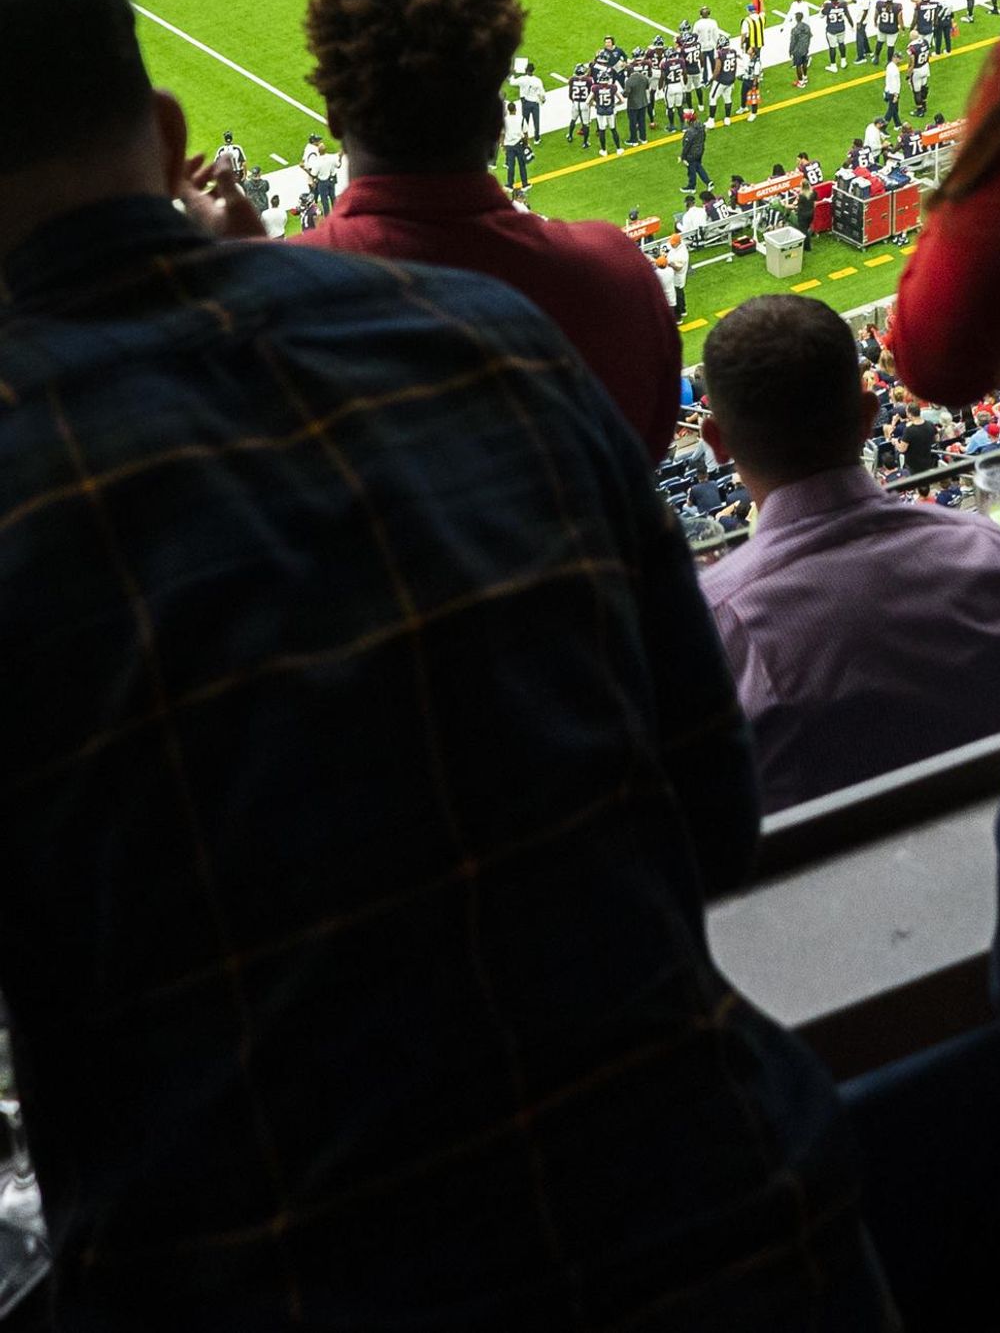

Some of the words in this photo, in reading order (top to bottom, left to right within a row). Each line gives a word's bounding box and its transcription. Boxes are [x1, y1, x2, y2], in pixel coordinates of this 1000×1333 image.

[829, 12, 845, 23] 93
[881, 12, 894, 23] 91
[924, 9, 935, 22] 41
[667, 69, 683, 82] 43
[572, 88, 588, 99] 23
[599, 95, 612, 105] 15
[807, 167, 823, 185] 83
[755, 181, 791, 198] GATORADE
[717, 204, 729, 219] 18
